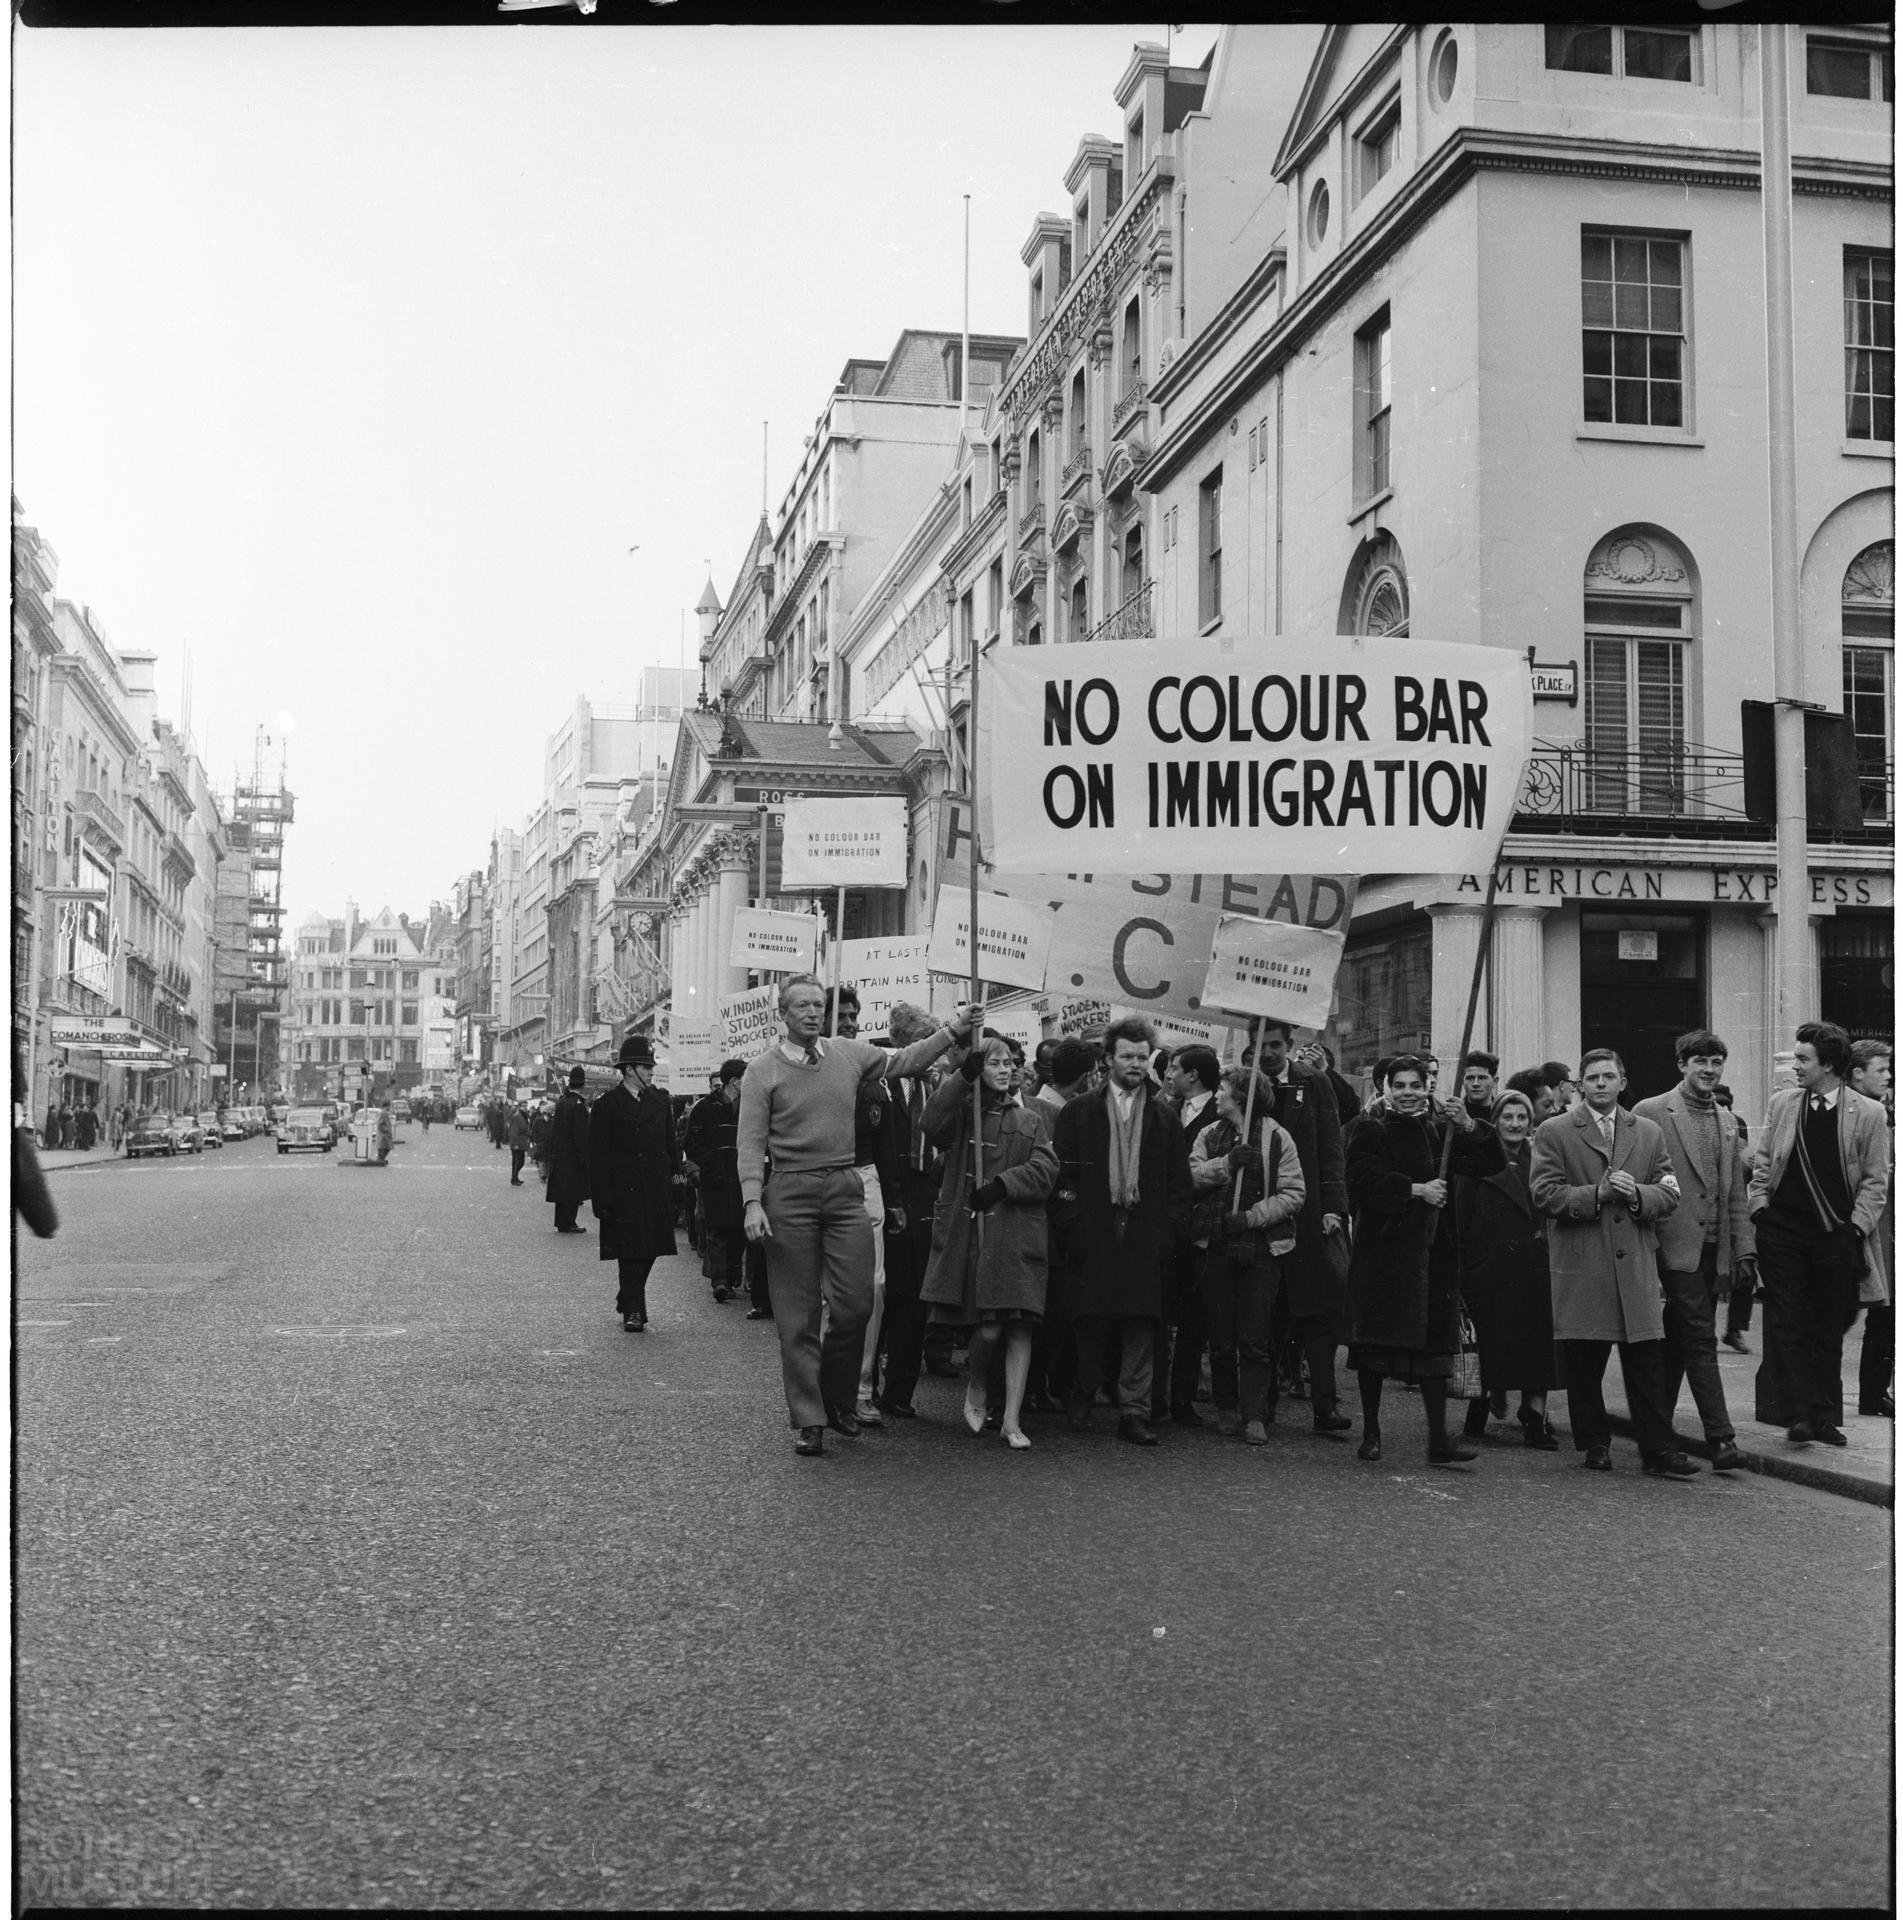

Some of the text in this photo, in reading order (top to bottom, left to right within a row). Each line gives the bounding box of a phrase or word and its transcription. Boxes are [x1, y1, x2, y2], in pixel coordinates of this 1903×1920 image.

[1537, 675, 1564, 691] PLACE
[1044, 674, 1492, 747] NO COLOUR BAR
[1043, 758, 1487, 830] ON IMMIGRATION
[808, 832, 881, 842] NO COLOUR BAR
[808, 848, 881, 857] ON IMMIGRATION
[1457, 867, 1872, 904] AMERICAN EXPESS
[759, 933, 783, 942] COLOUR
[785, 935, 798, 943] BAR
[957, 923, 1029, 945] NO OLOUR BAR
[758, 943, 797, 953] IMMIGRATION
[866, 944, 930, 960] AT LAST!
[955, 938, 1026, 960] ON MMIGRATION
[1238, 955, 1312, 977] NO COLOUR BAR
[896, 974, 920, 985] HAS
[1235, 971, 1308, 993] ON IMMIGRATION
[870, 999, 903, 1012] TH
[83, 1018, 105, 1028] THE
[729, 1007, 786, 1034] STUDET
[857, 1021, 890, 1033] LOU
[1060, 1010, 1110, 1036] WORKERS
[51, 1030, 129, 1042] COMANCHEROS
[728, 1025, 777, 1048] SHOCKED
[1153, 1018, 1162, 1027] ON
[1165, 1020, 1210, 1040] IMMIGRATION
[1848, 1028, 1893, 1038] MERICA
[109, 1050, 163, 1059] CARLTON
[733, 1048, 764, 1061] COLO
